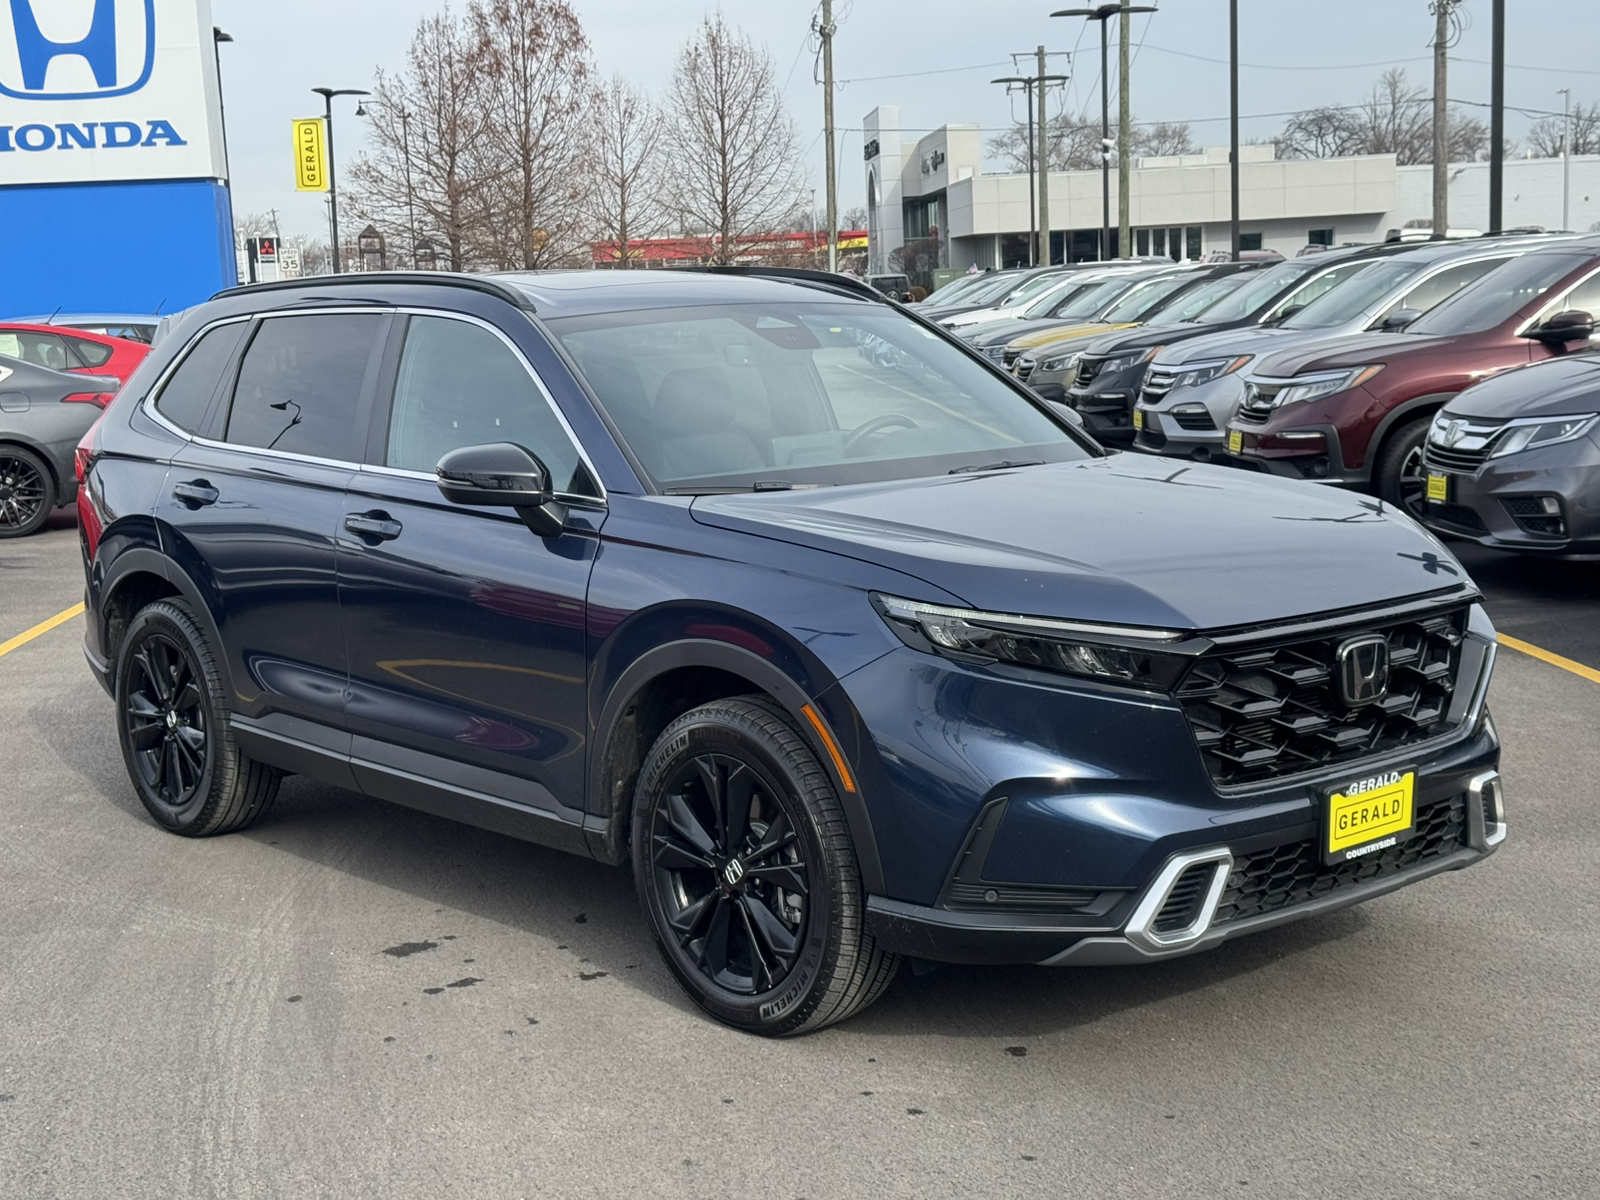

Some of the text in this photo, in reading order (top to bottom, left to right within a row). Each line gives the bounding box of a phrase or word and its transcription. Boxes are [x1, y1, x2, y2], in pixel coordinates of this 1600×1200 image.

[304, 127, 316, 181] GERALD
[282, 260, 298, 269] 35
[646, 734, 687, 787] MICHELIN
[1349, 771, 1399, 795] GERALD
[1339, 799, 1400, 830] GERALD
[1346, 837, 1396, 859] COUNTRYSIDE
[762, 969, 808, 1018] MICHELIN
